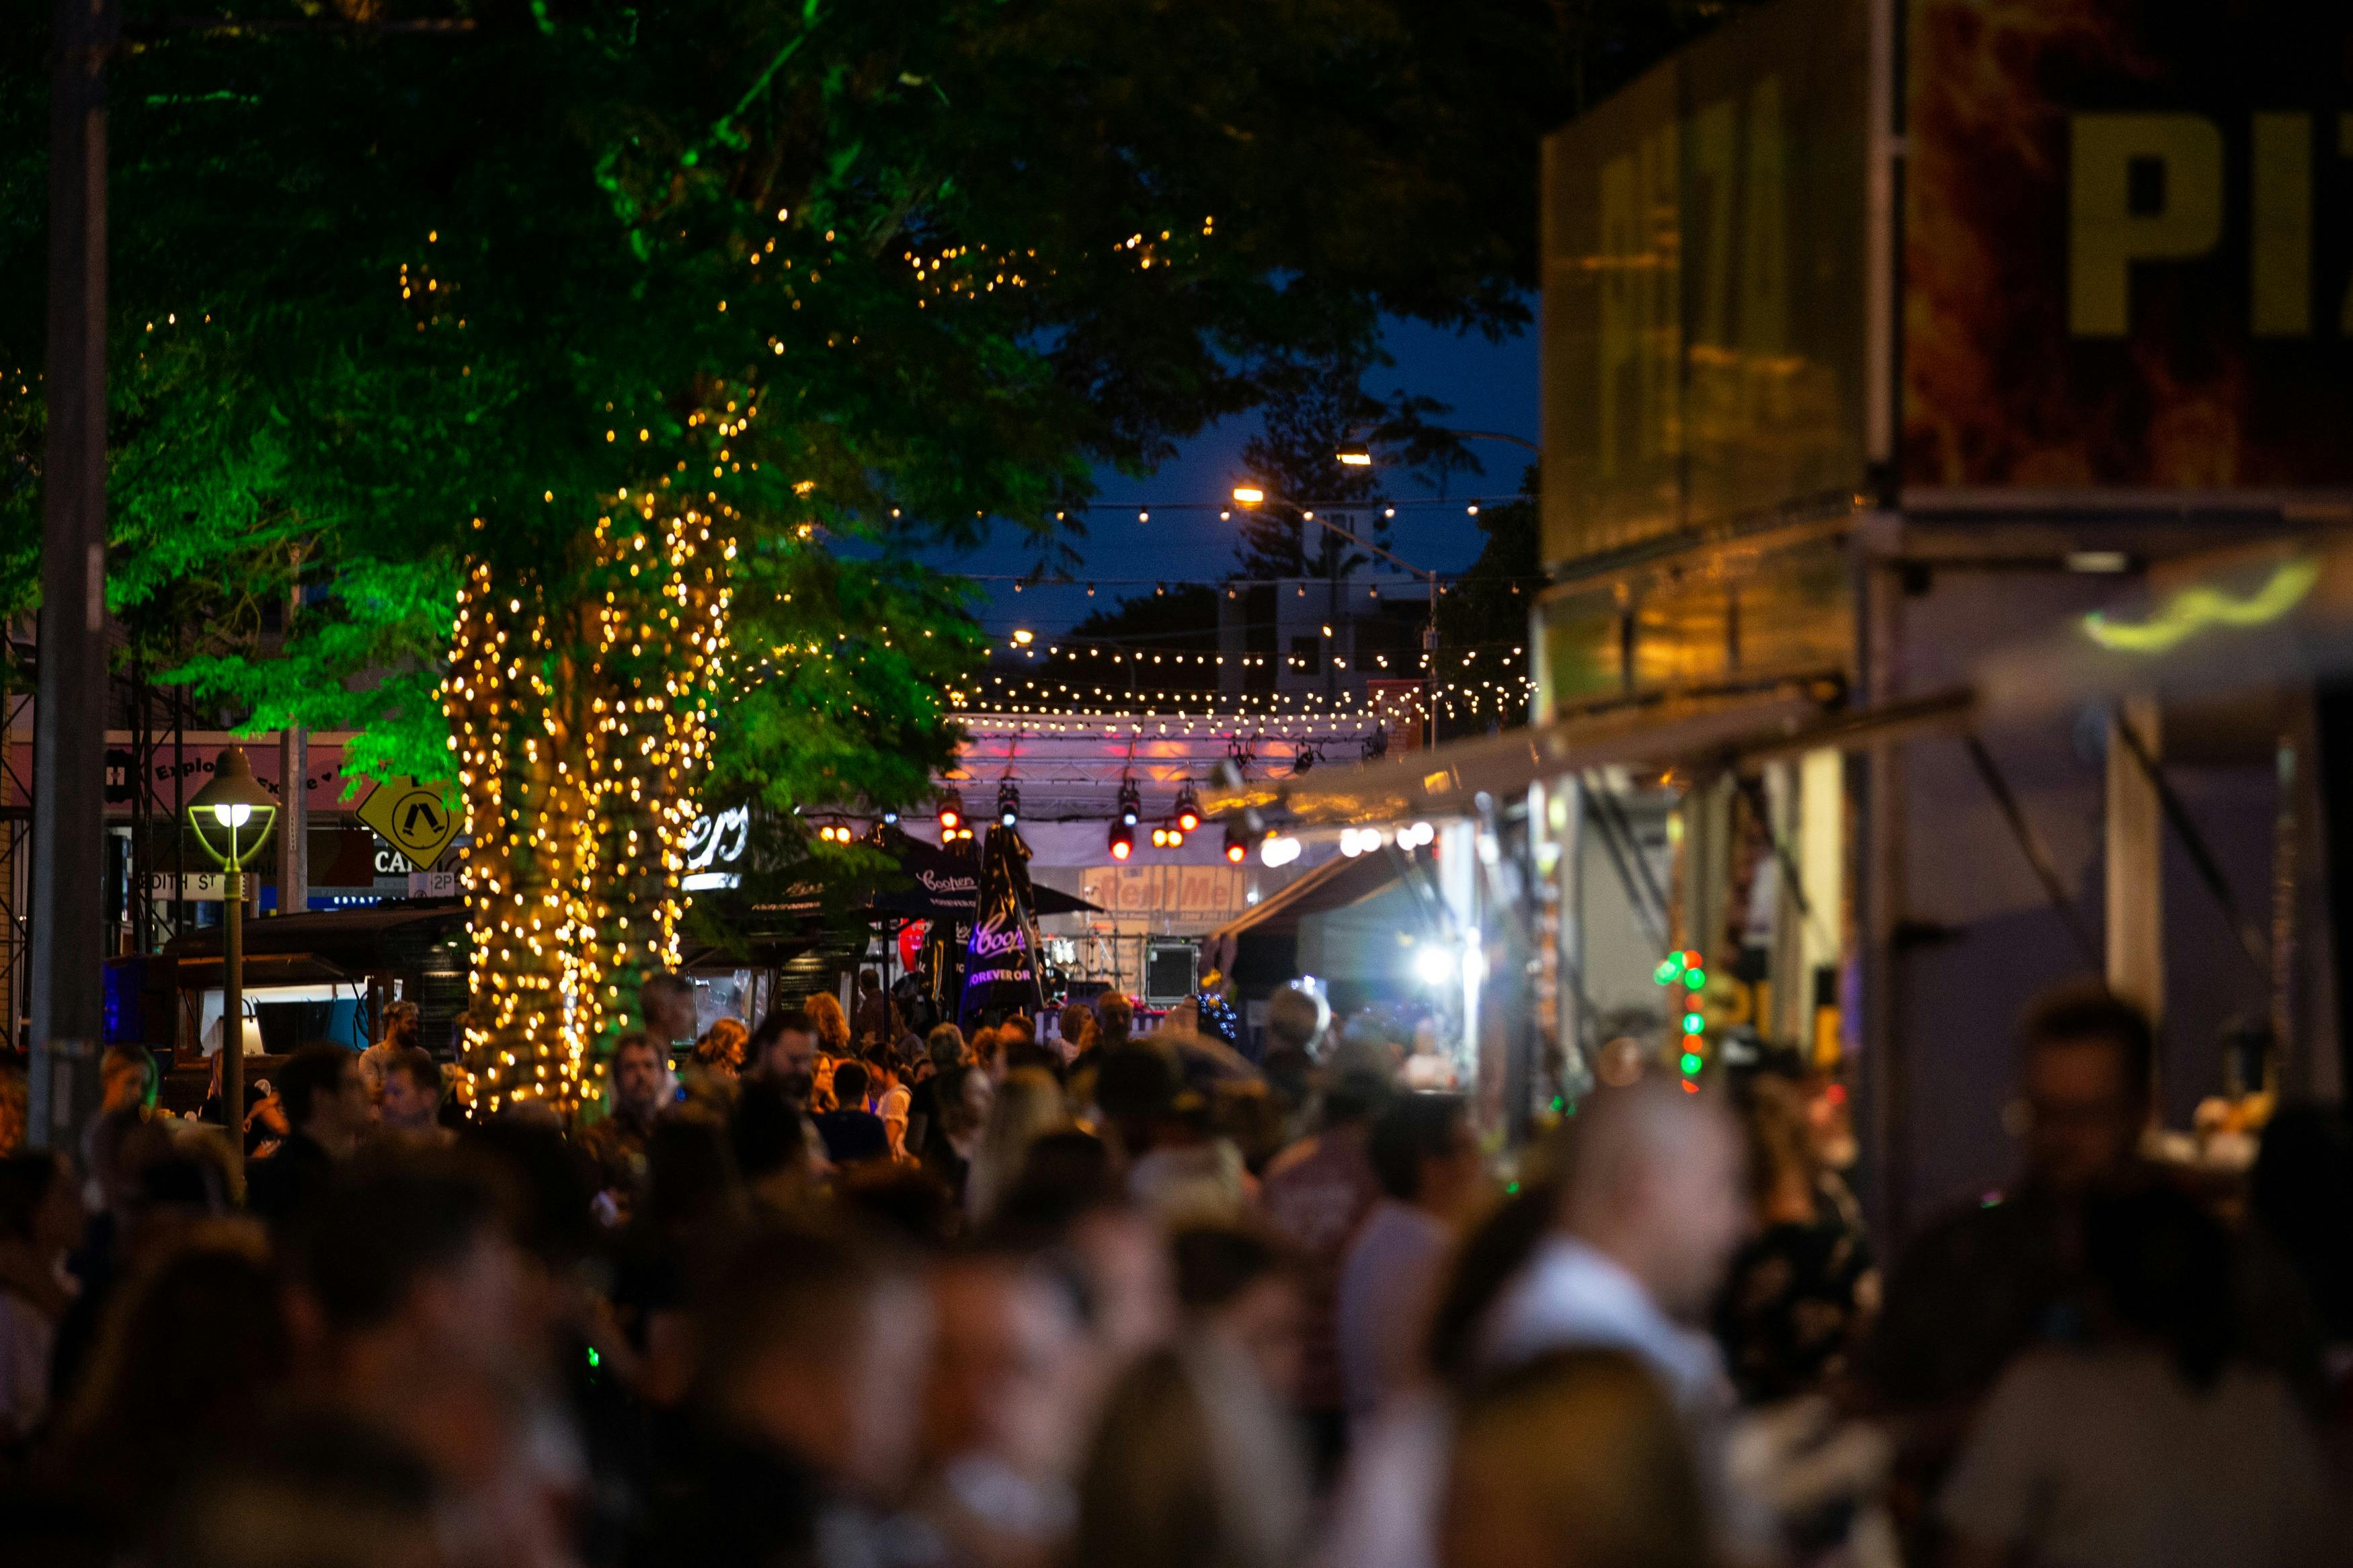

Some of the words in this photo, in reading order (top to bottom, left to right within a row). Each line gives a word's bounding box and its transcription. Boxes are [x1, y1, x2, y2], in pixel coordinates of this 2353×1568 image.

[2069, 108, 2353, 338] PI
[155, 757, 215, 780] Eplo
[434, 875, 452, 890] 2P
[970, 968, 1013, 986] OREVER
